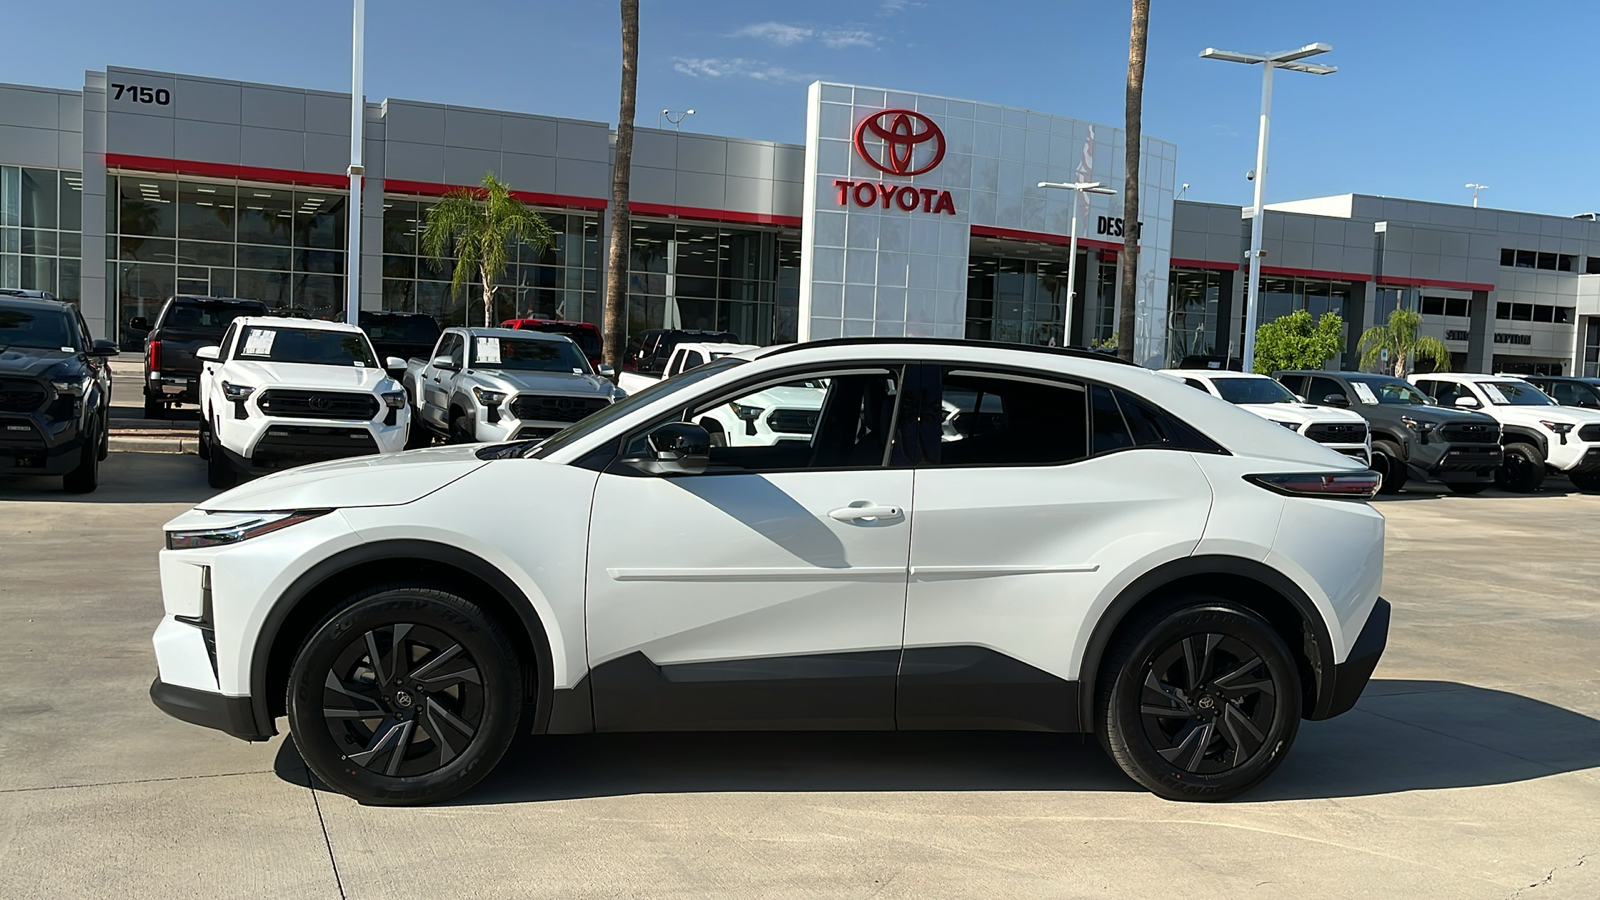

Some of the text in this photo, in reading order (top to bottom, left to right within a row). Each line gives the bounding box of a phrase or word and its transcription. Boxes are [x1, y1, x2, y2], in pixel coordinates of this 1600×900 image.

[111, 83, 170, 106] 7150
[833, 180, 956, 215] TOYOTA
[1097, 215, 1143, 240] DEST
